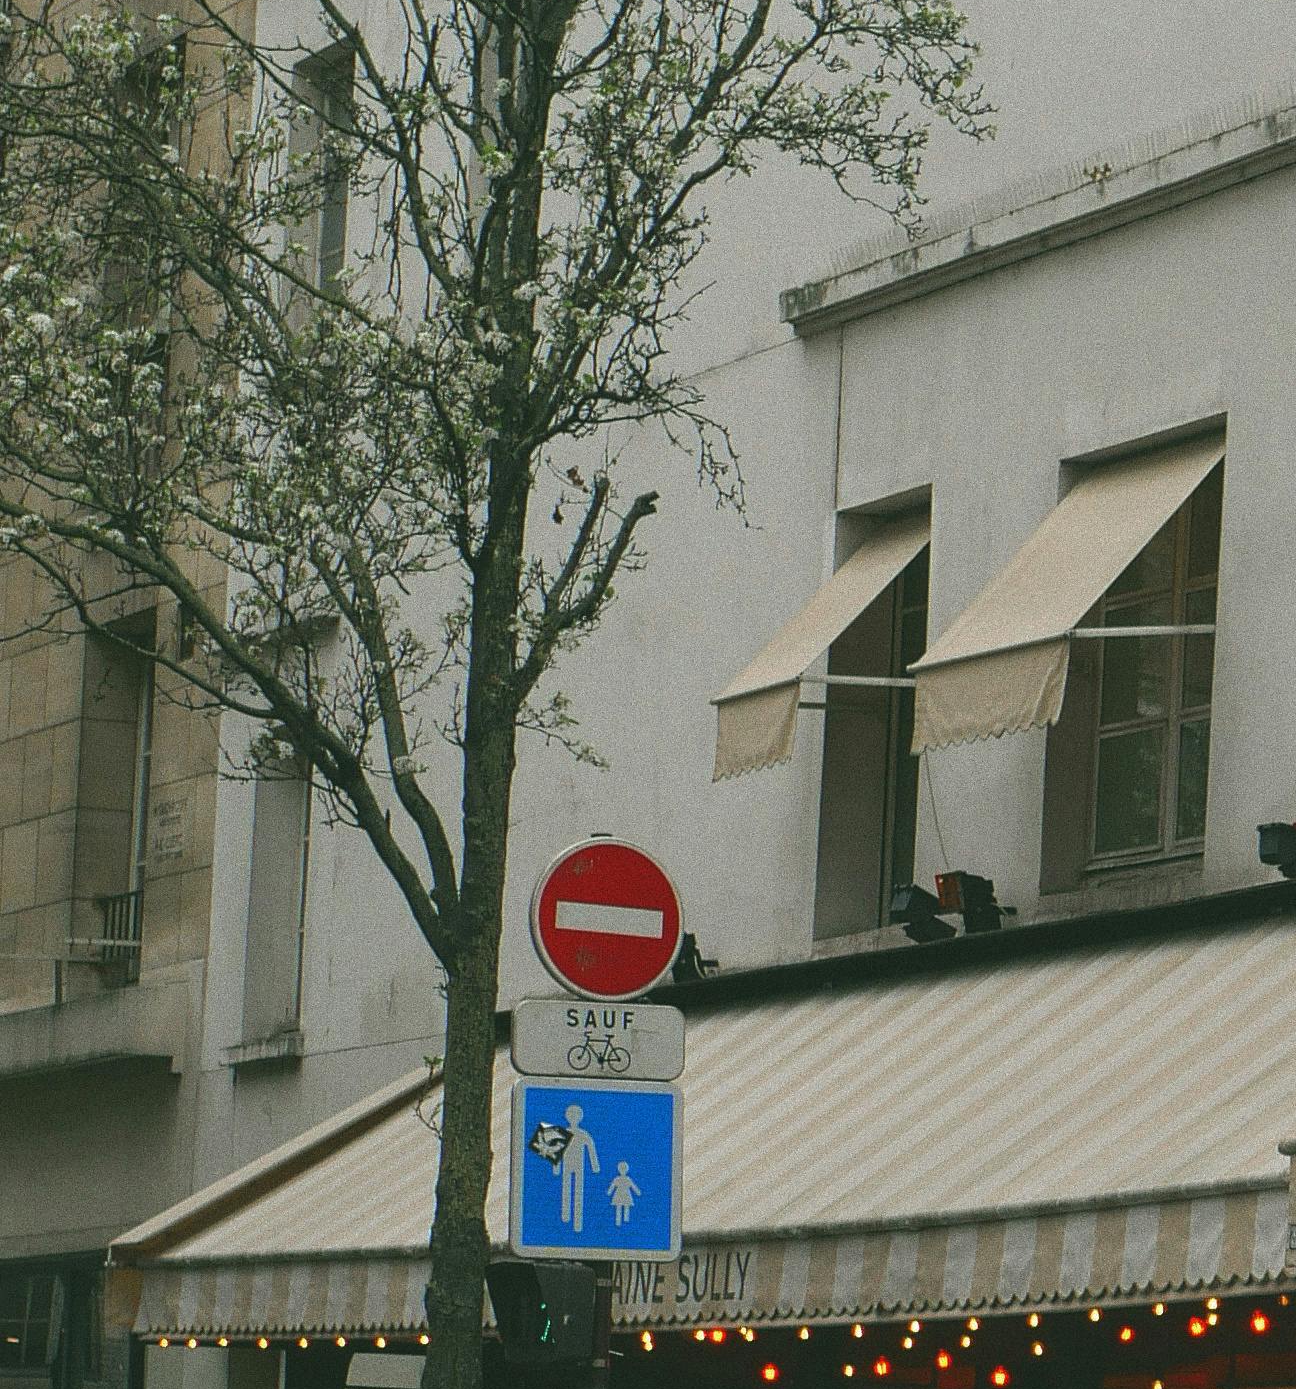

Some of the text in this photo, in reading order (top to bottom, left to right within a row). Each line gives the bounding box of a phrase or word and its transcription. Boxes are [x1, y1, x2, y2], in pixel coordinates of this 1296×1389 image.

[566, 1009, 634, 1030] SAUF
[612, 1252, 750, 1305] AINE SULLY
